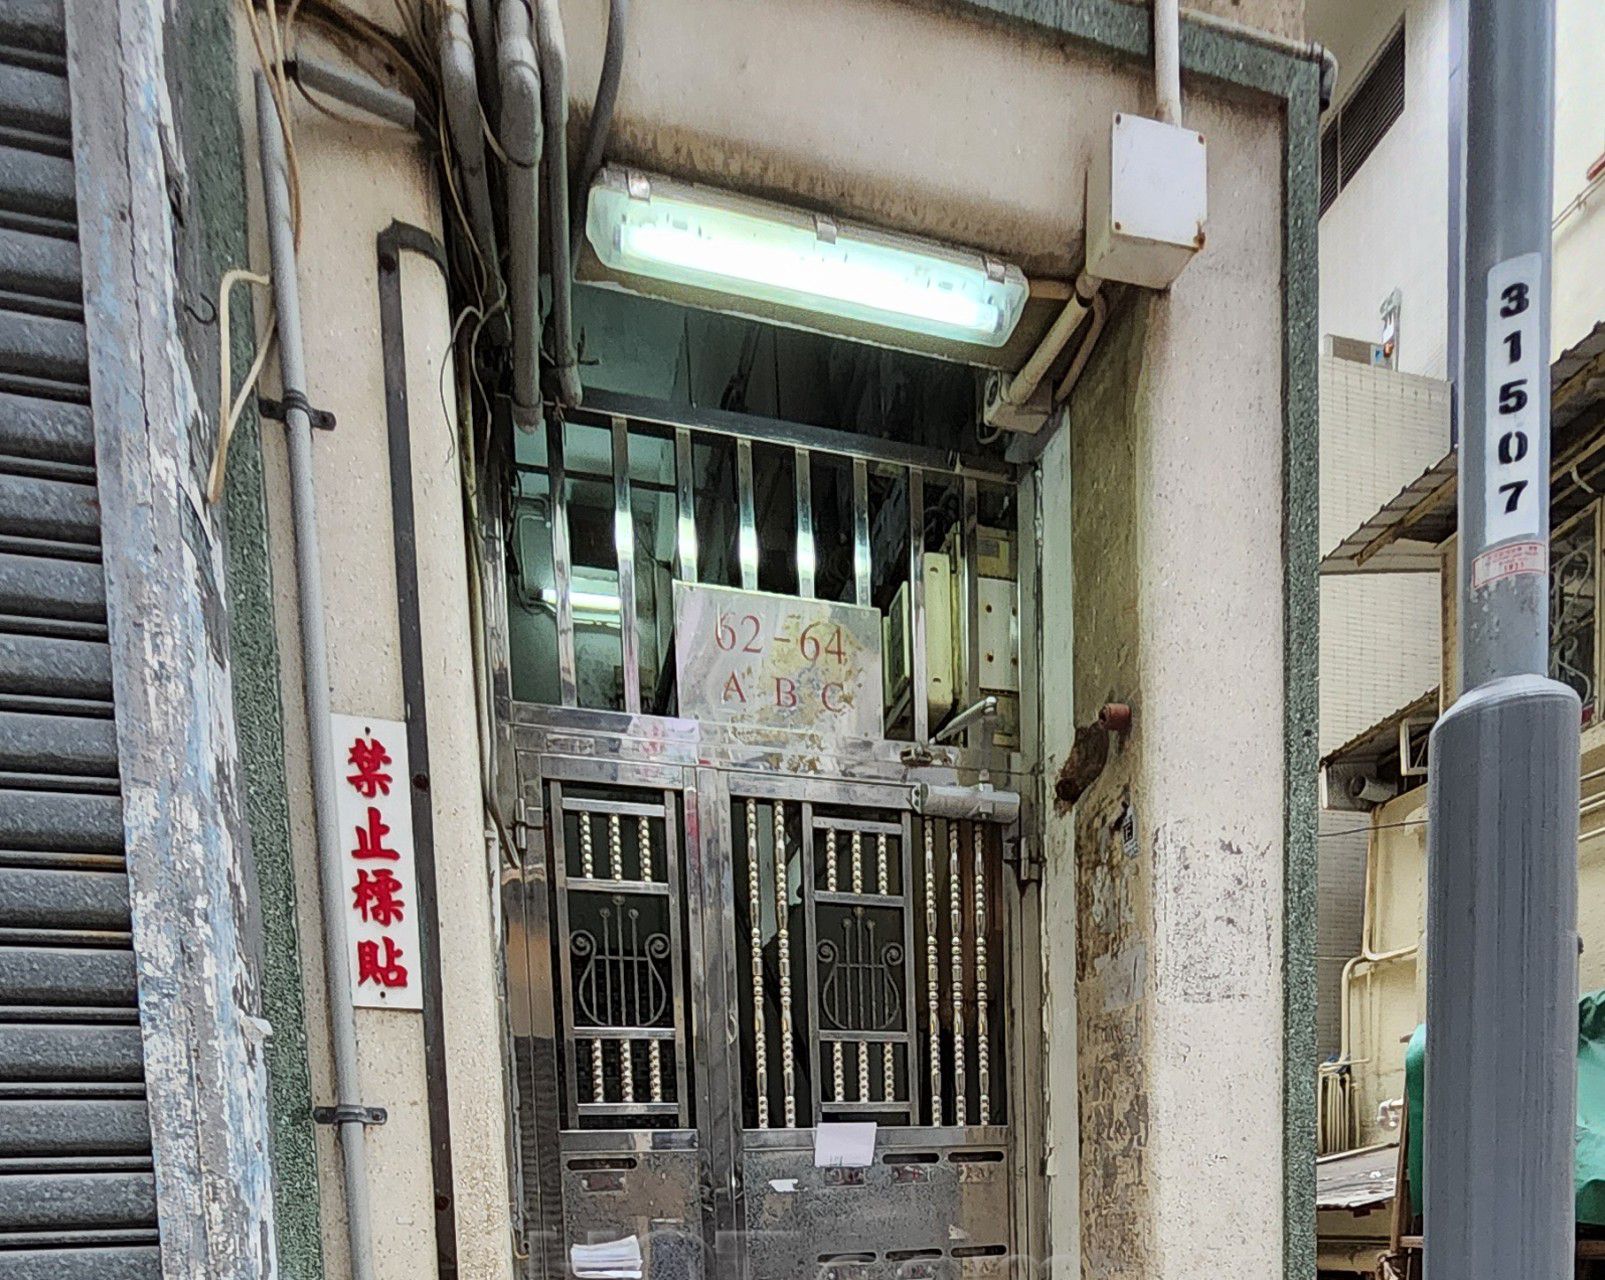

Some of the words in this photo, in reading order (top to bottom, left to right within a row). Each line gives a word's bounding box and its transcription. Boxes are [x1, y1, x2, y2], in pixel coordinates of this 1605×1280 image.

[1498, 282, 1530, 514] 31507
[723, 671, 747, 704] A
[773, 676, 798, 708] B
[821, 681, 847, 713] C
[346, 737, 409, 988] 禁止標貼
